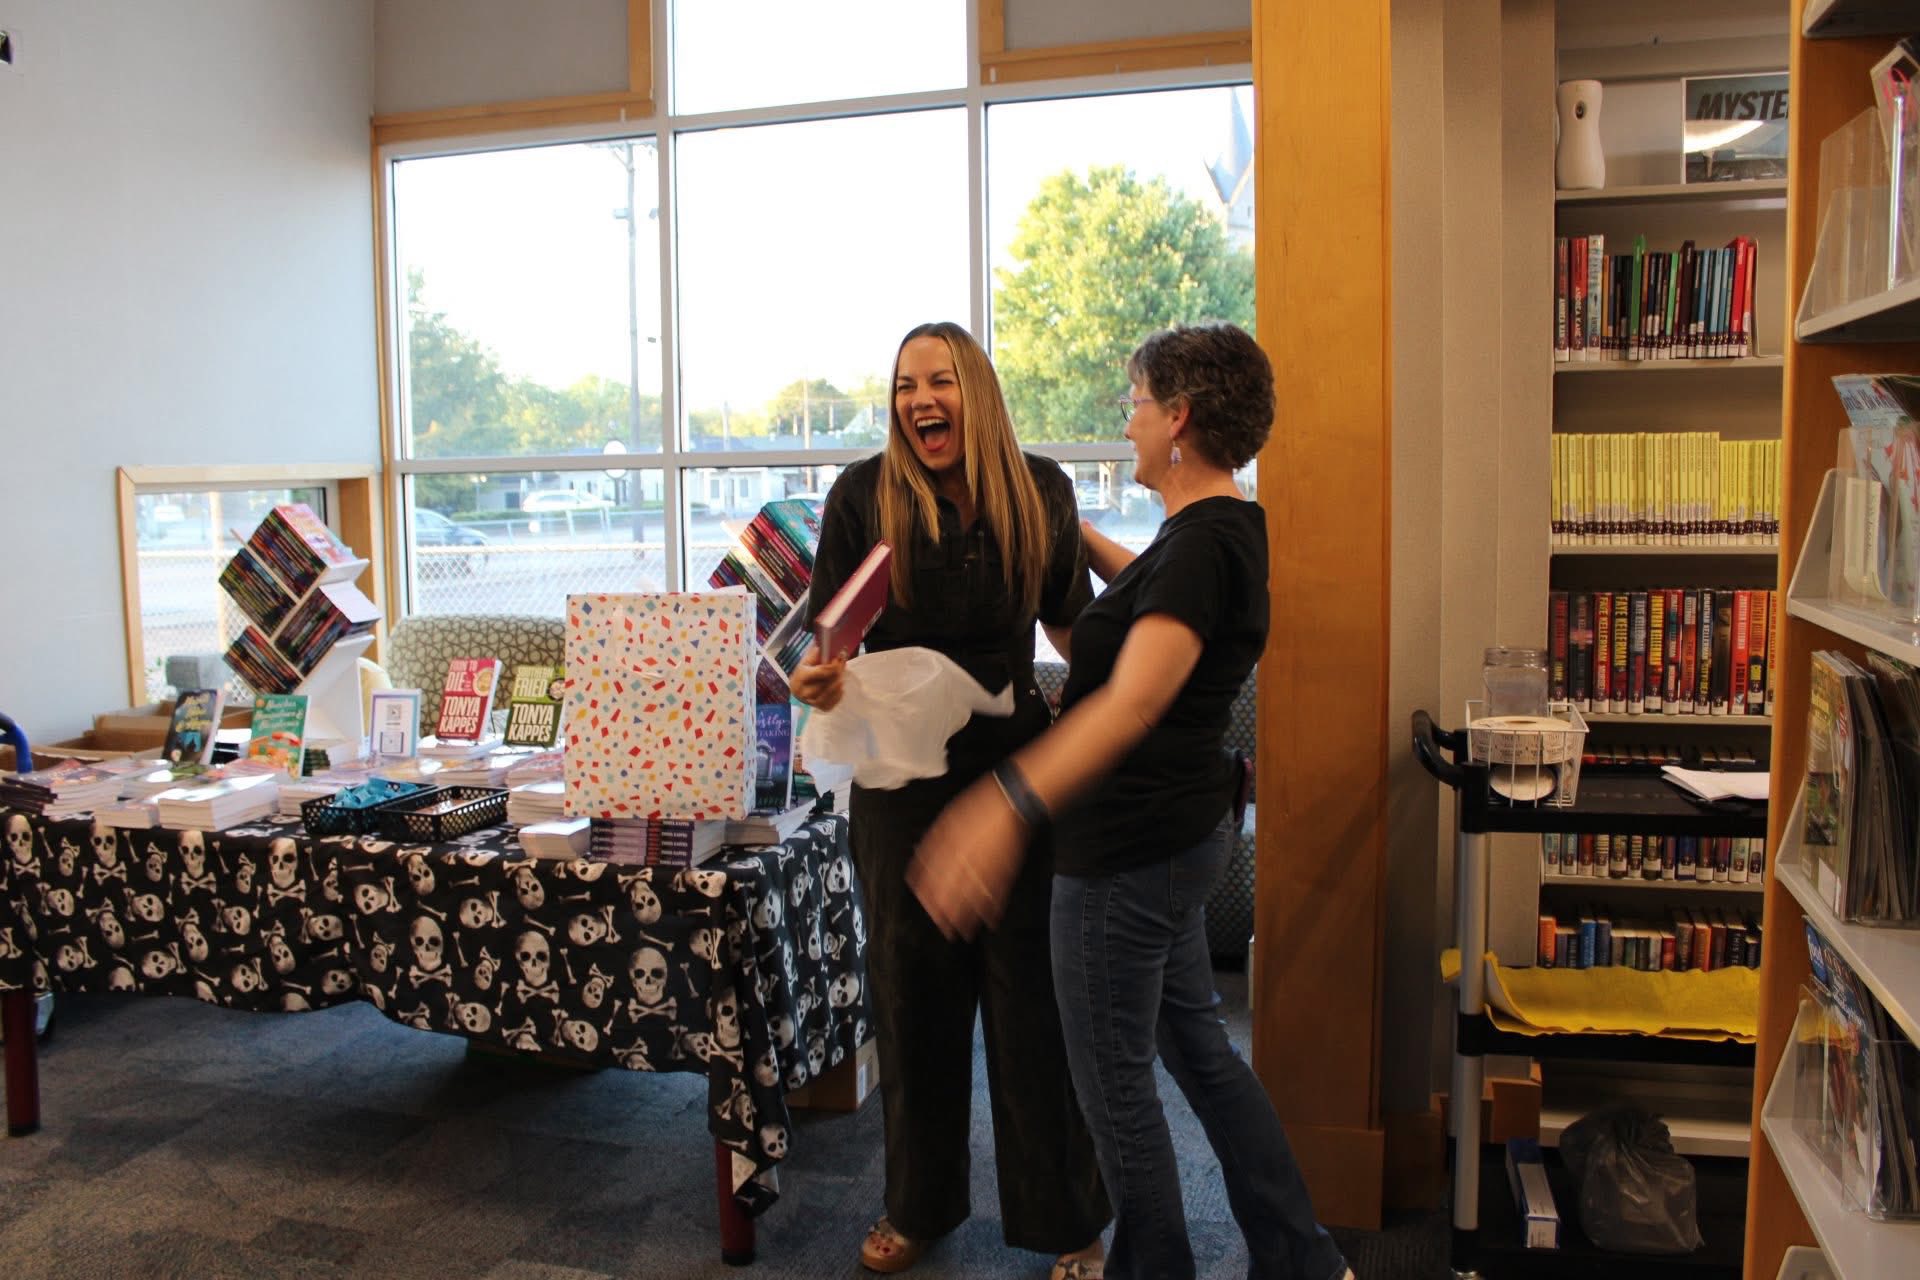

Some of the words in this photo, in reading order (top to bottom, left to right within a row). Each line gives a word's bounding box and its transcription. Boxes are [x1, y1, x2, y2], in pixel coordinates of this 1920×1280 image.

[1696, 89, 1789, 120] MYSTE
[1599, 597, 1609, 616] FAYE
[1615, 596, 1628, 616] FAYE
[1703, 593, 1711, 623] JONATHAN
[1598, 617, 1608, 662] KELLERMAN
[1614, 618, 1628, 666] KELLERMAN
[1702, 624, 1710, 660] KELLERMAN
[445, 671, 468, 691] DIE
[512, 678, 548, 697] FRIED
[442, 696, 481, 716] TONYA
[512, 703, 555, 725] TONYA
[438, 716, 478, 733] KAPPES
[508, 724, 552, 742] KAPPES
